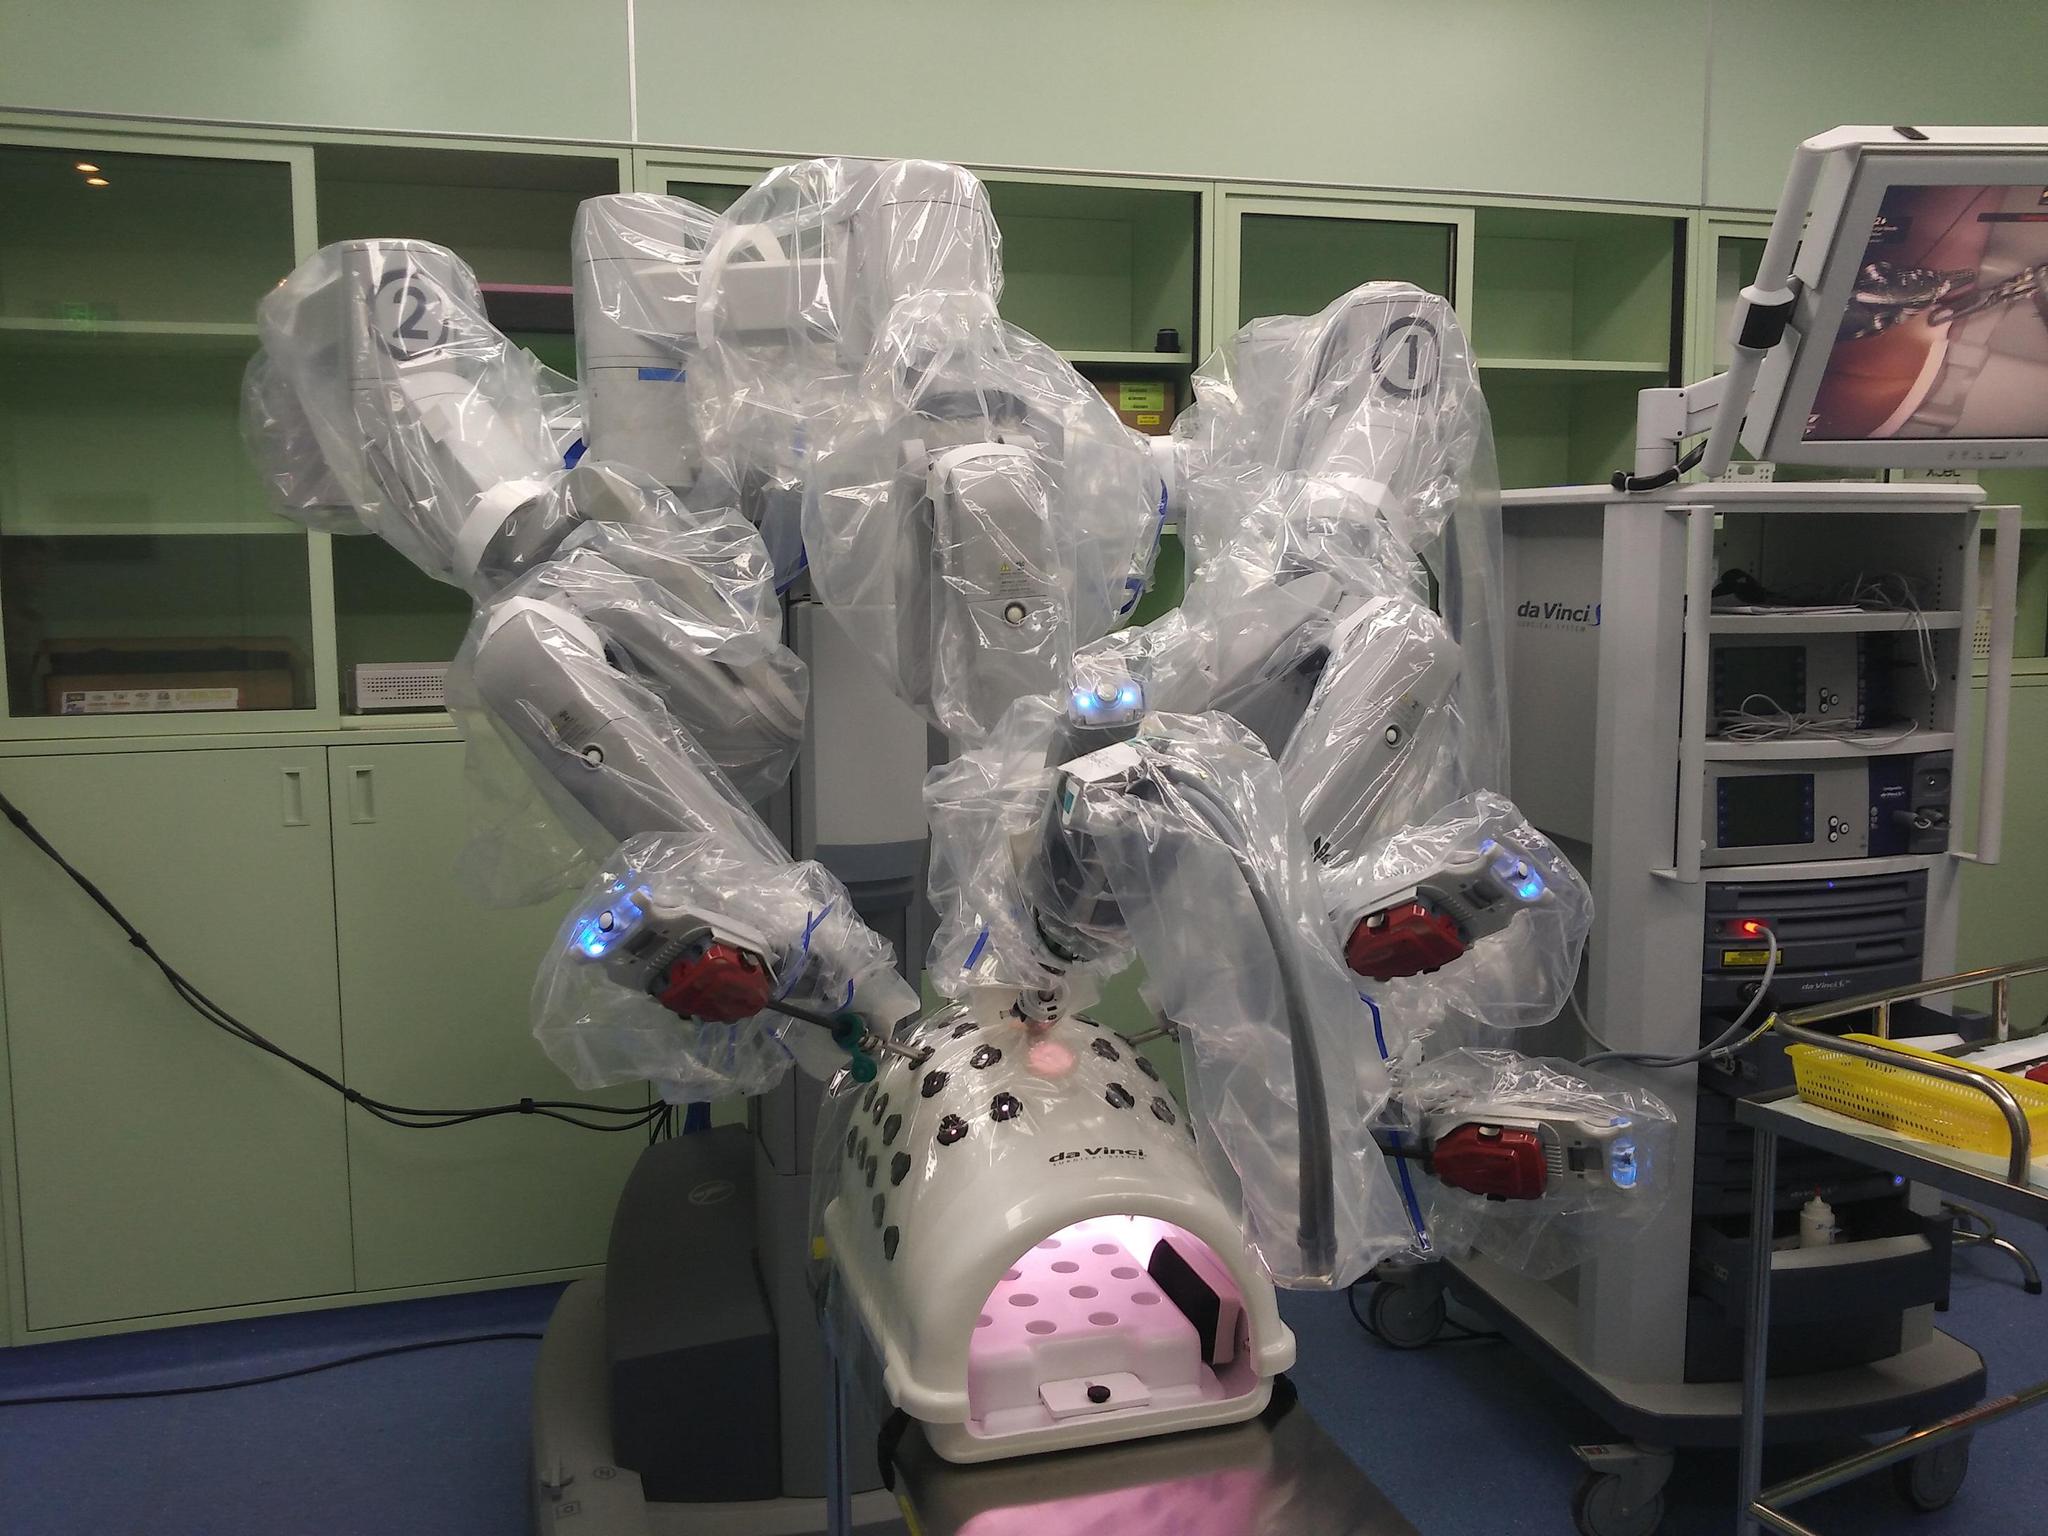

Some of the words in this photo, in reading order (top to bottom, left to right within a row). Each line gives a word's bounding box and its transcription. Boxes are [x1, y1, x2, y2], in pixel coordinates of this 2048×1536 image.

[393, 286, 428, 339] 2
[1405, 334, 1418, 379] 1
[1517, 600, 1540, 618] da
[1544, 602, 1590, 622] Vinci
[1049, 1152, 1080, 1162] da
[1084, 1146, 1144, 1157] Vinci
